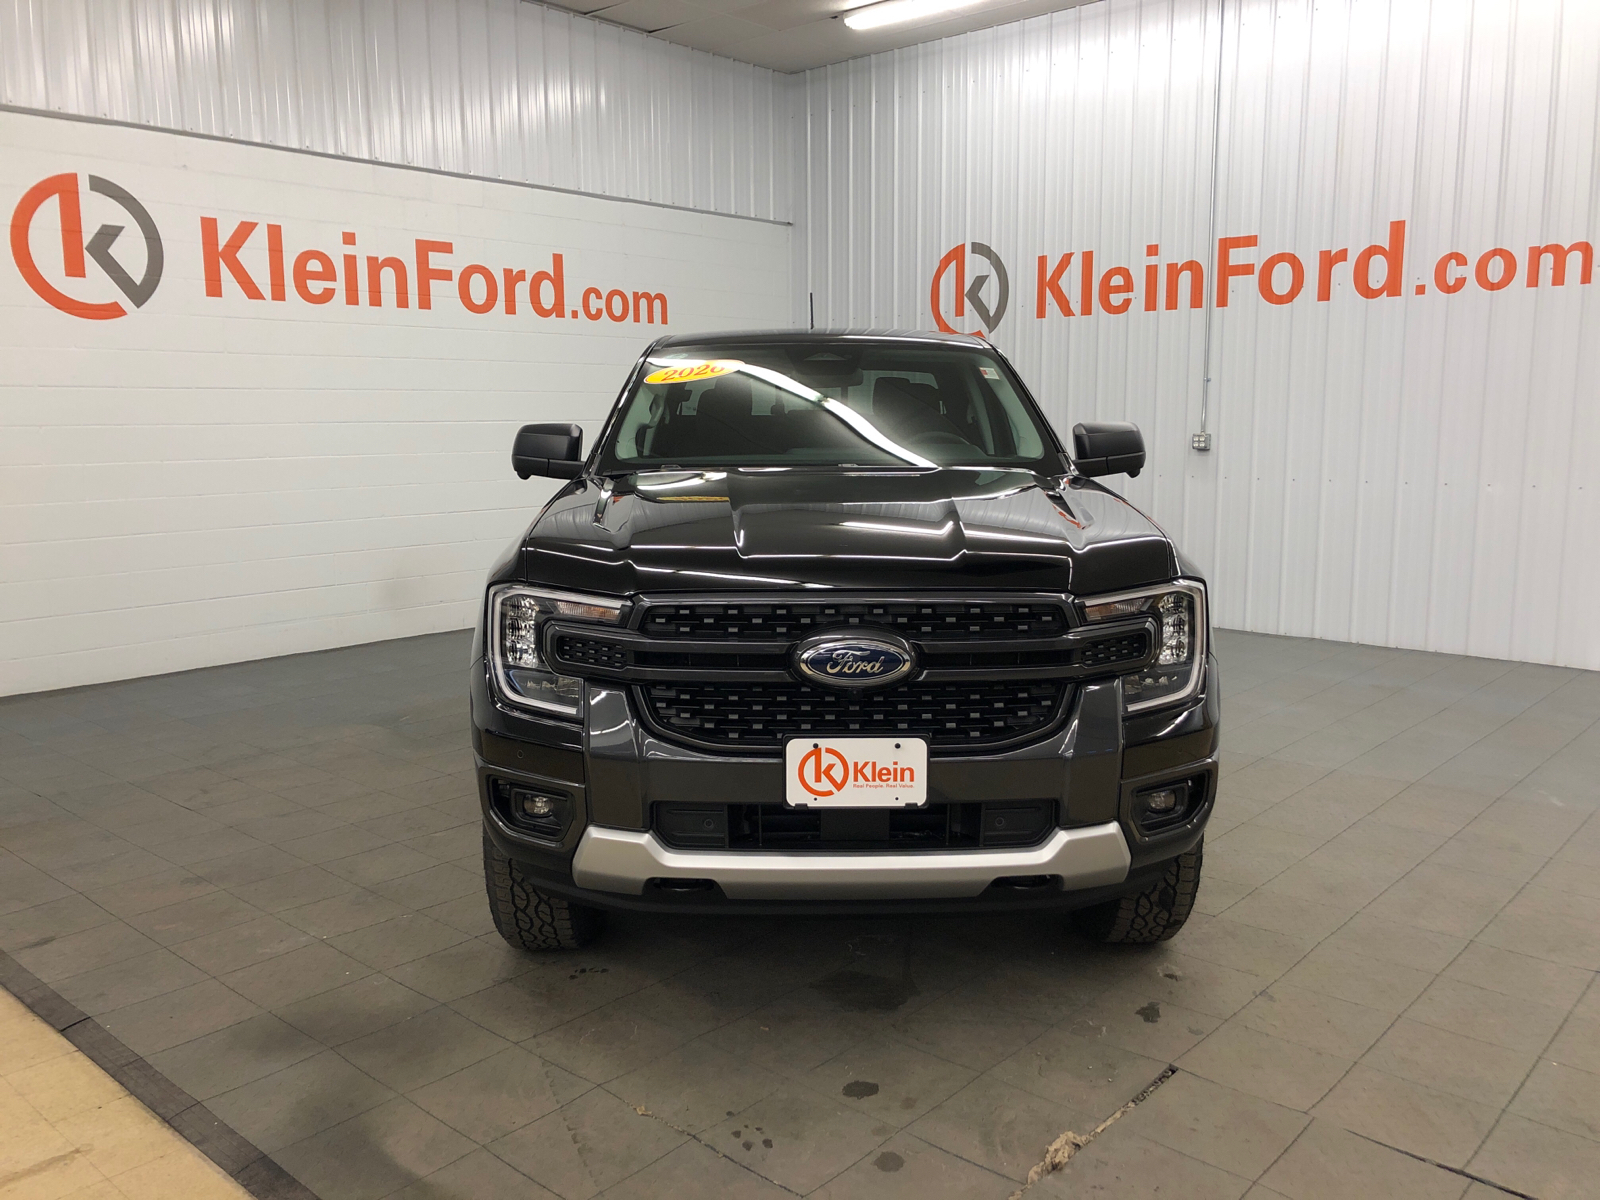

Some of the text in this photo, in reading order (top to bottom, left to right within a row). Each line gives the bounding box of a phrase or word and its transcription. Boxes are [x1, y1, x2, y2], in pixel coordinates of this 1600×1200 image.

[200, 216, 669, 326] KleinFord.com
[1036, 219, 1595, 320] KleinFord.com
[826, 649, 885, 674] Ford
[853, 761, 915, 783] Klein
